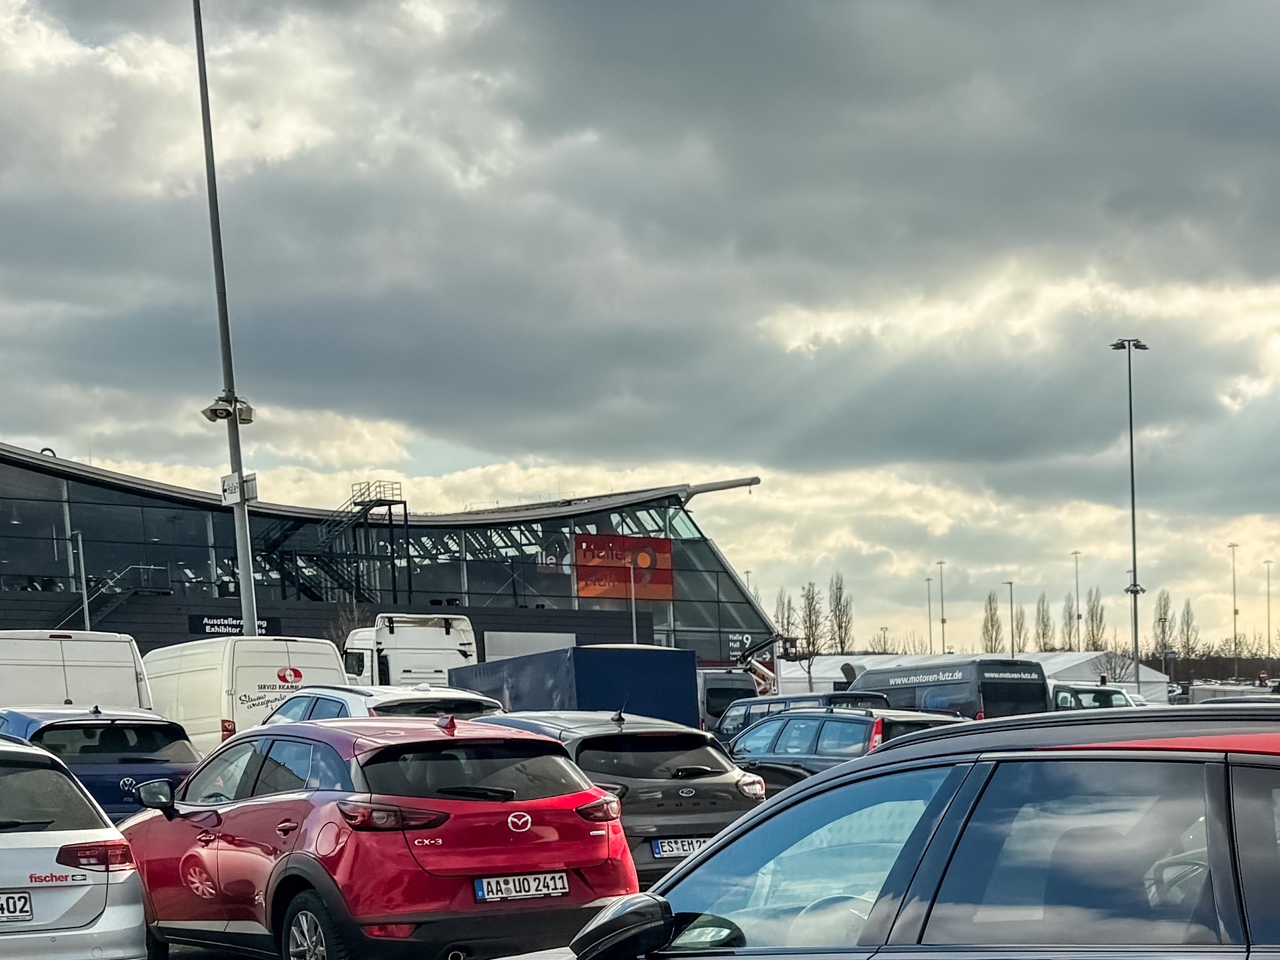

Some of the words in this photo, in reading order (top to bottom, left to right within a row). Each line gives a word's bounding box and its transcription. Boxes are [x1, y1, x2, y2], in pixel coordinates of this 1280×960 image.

[743, 634, 752, 648] 9
[889, 670, 963, 685] www.motoren-lutz.de
[660, 841, 674, 852] ES
[29, 873, 69, 883] fischer
[486, 880, 503, 896] AA
[533, 875, 567, 892] 2411
